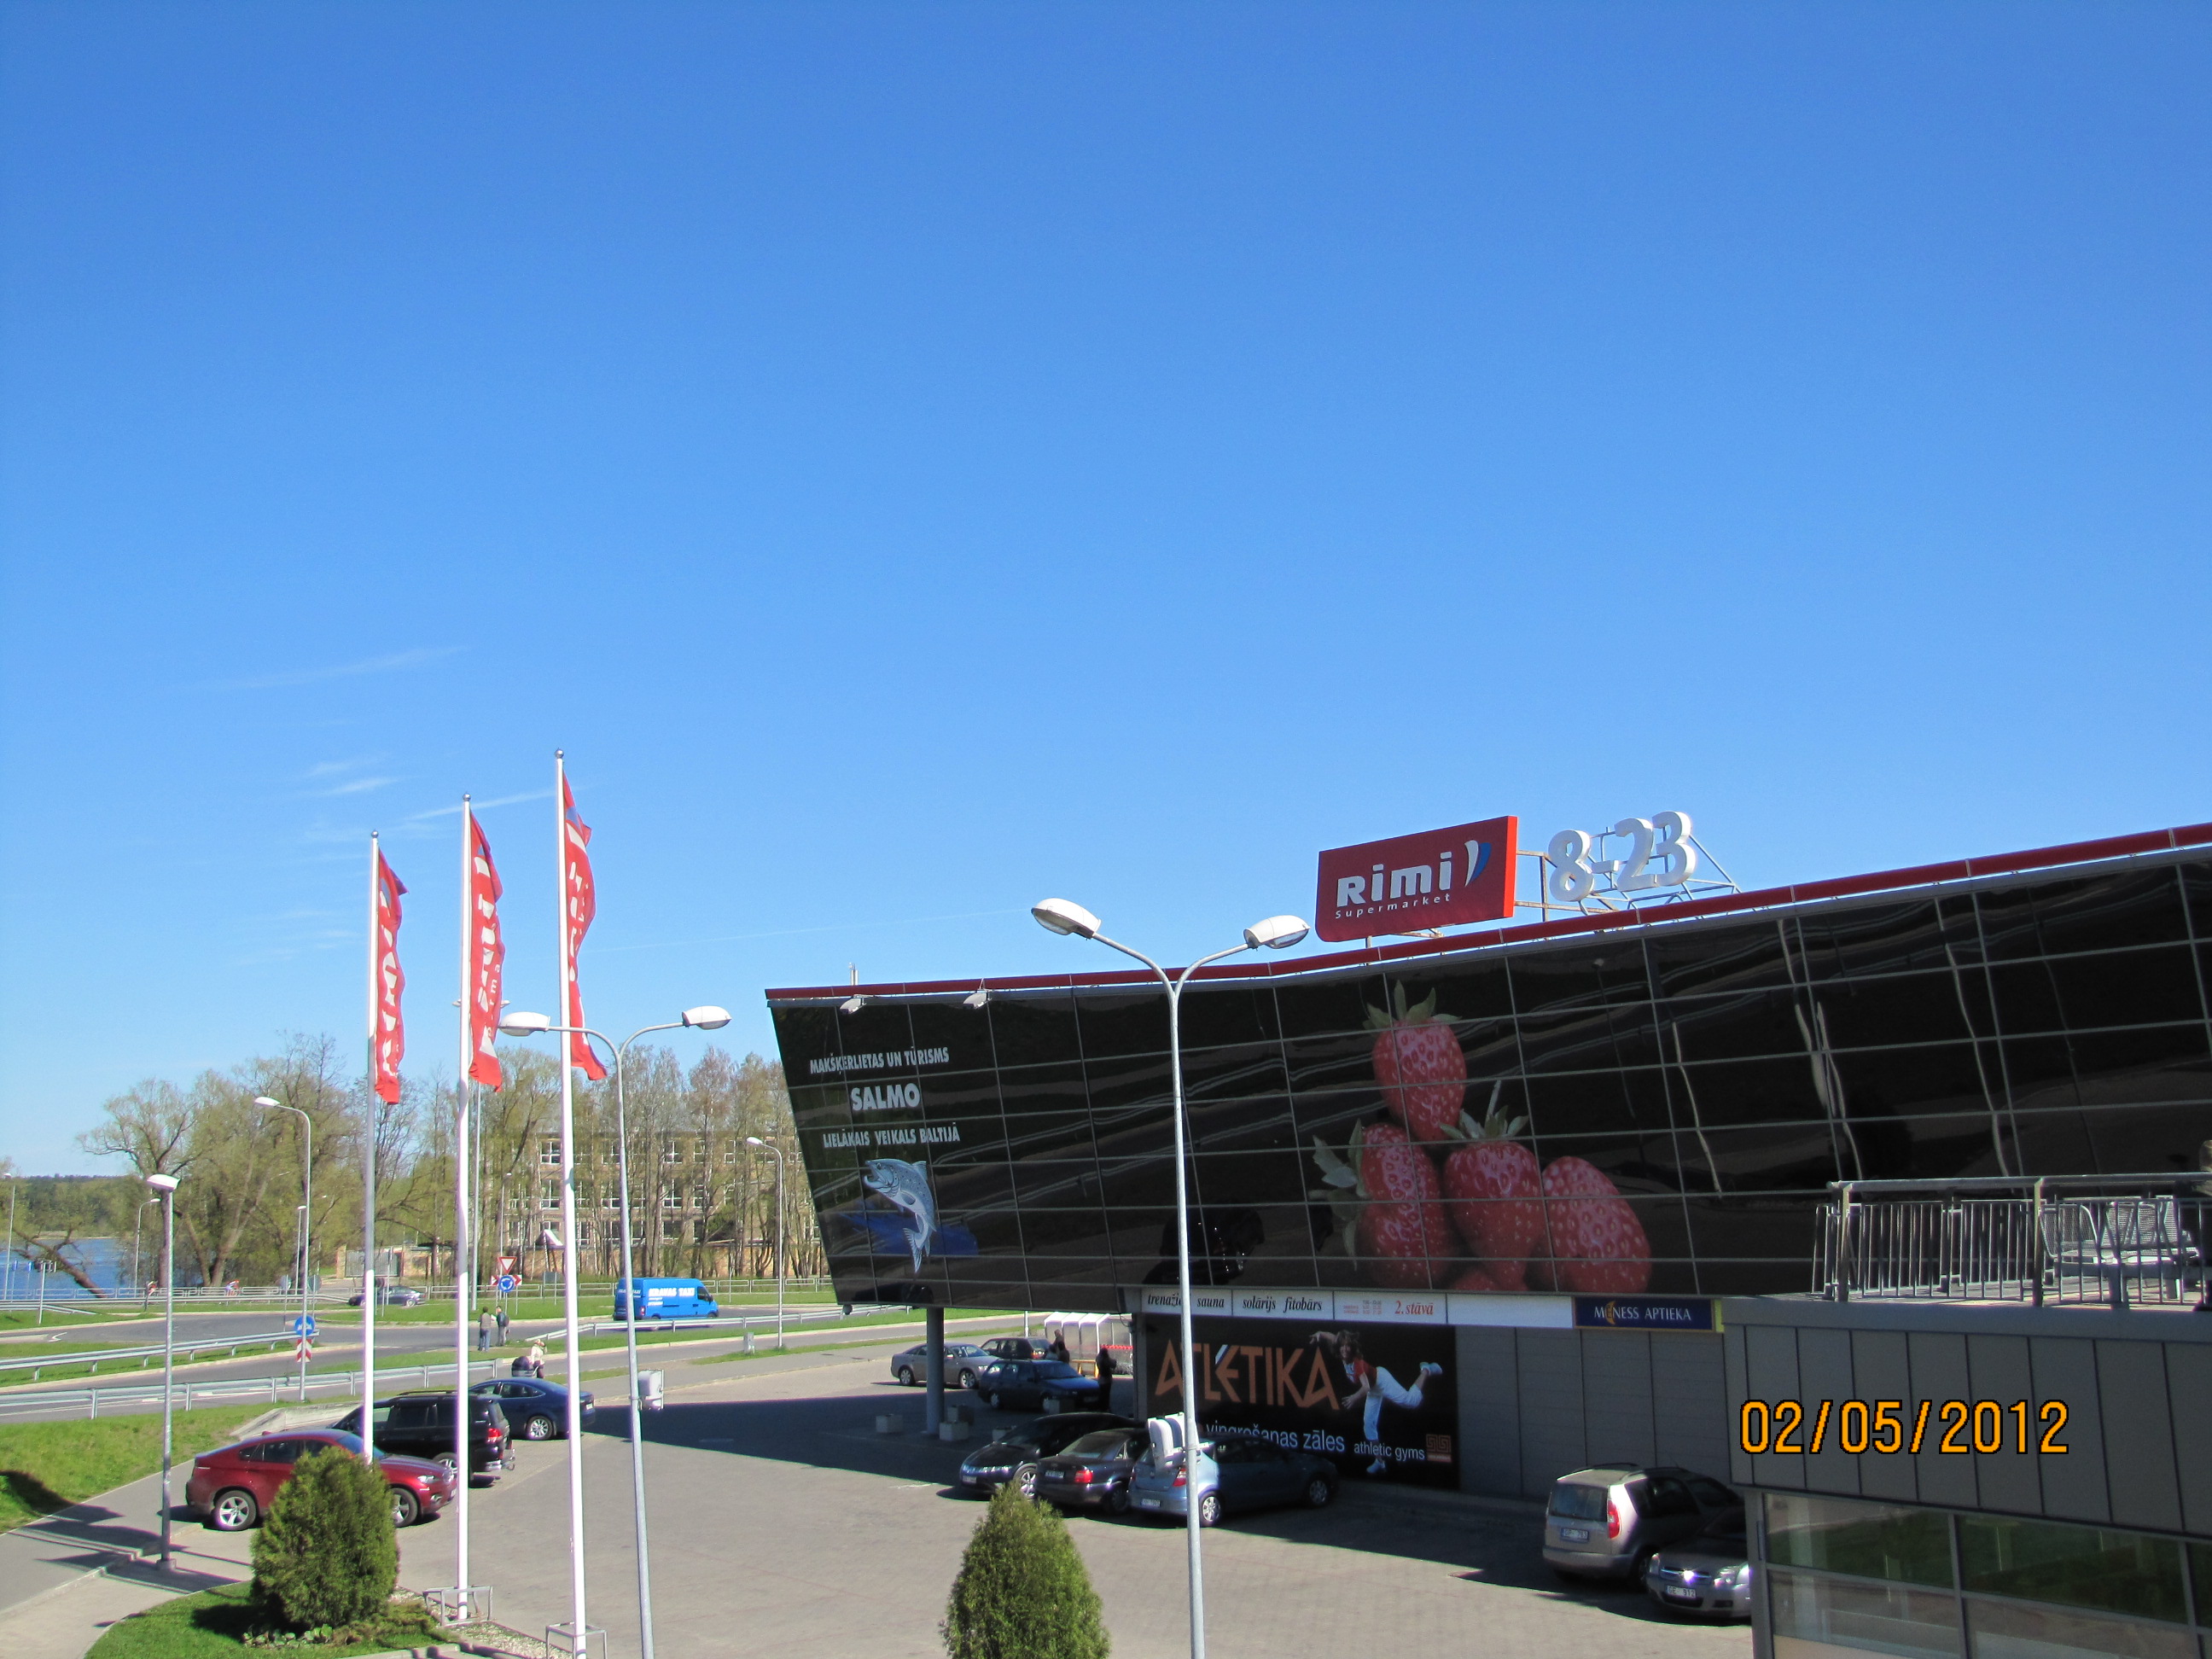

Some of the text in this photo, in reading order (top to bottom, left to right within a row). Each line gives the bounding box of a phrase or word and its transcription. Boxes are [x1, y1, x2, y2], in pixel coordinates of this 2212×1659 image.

[1548, 811, 1697, 902] 8-23
[1336, 852, 1452, 907] Rimi
[1335, 893, 1451, 920] Supermarket
[810, 1046, 950, 1074] MAKŠĶERLIETAS UN TŪRISMS
[851, 1083, 921, 1111] SALMO
[823, 1122, 961, 1149] LIELĀKAIS VEIKALS BALTIJĀ
[1196, 1295, 1225, 1308] sauna
[1243, 1295, 1277, 1313] solārijs
[1283, 1296, 1323, 1313] fitobārs
[1406, 1301, 1434, 1315] stāvā
[1644, 1307, 1692, 1321] APTIEKA
[1303, 1429, 1346, 1452] zāles
[1353, 1441, 1392, 1458] athletic
[1394, 1446, 1426, 1460] gyms
